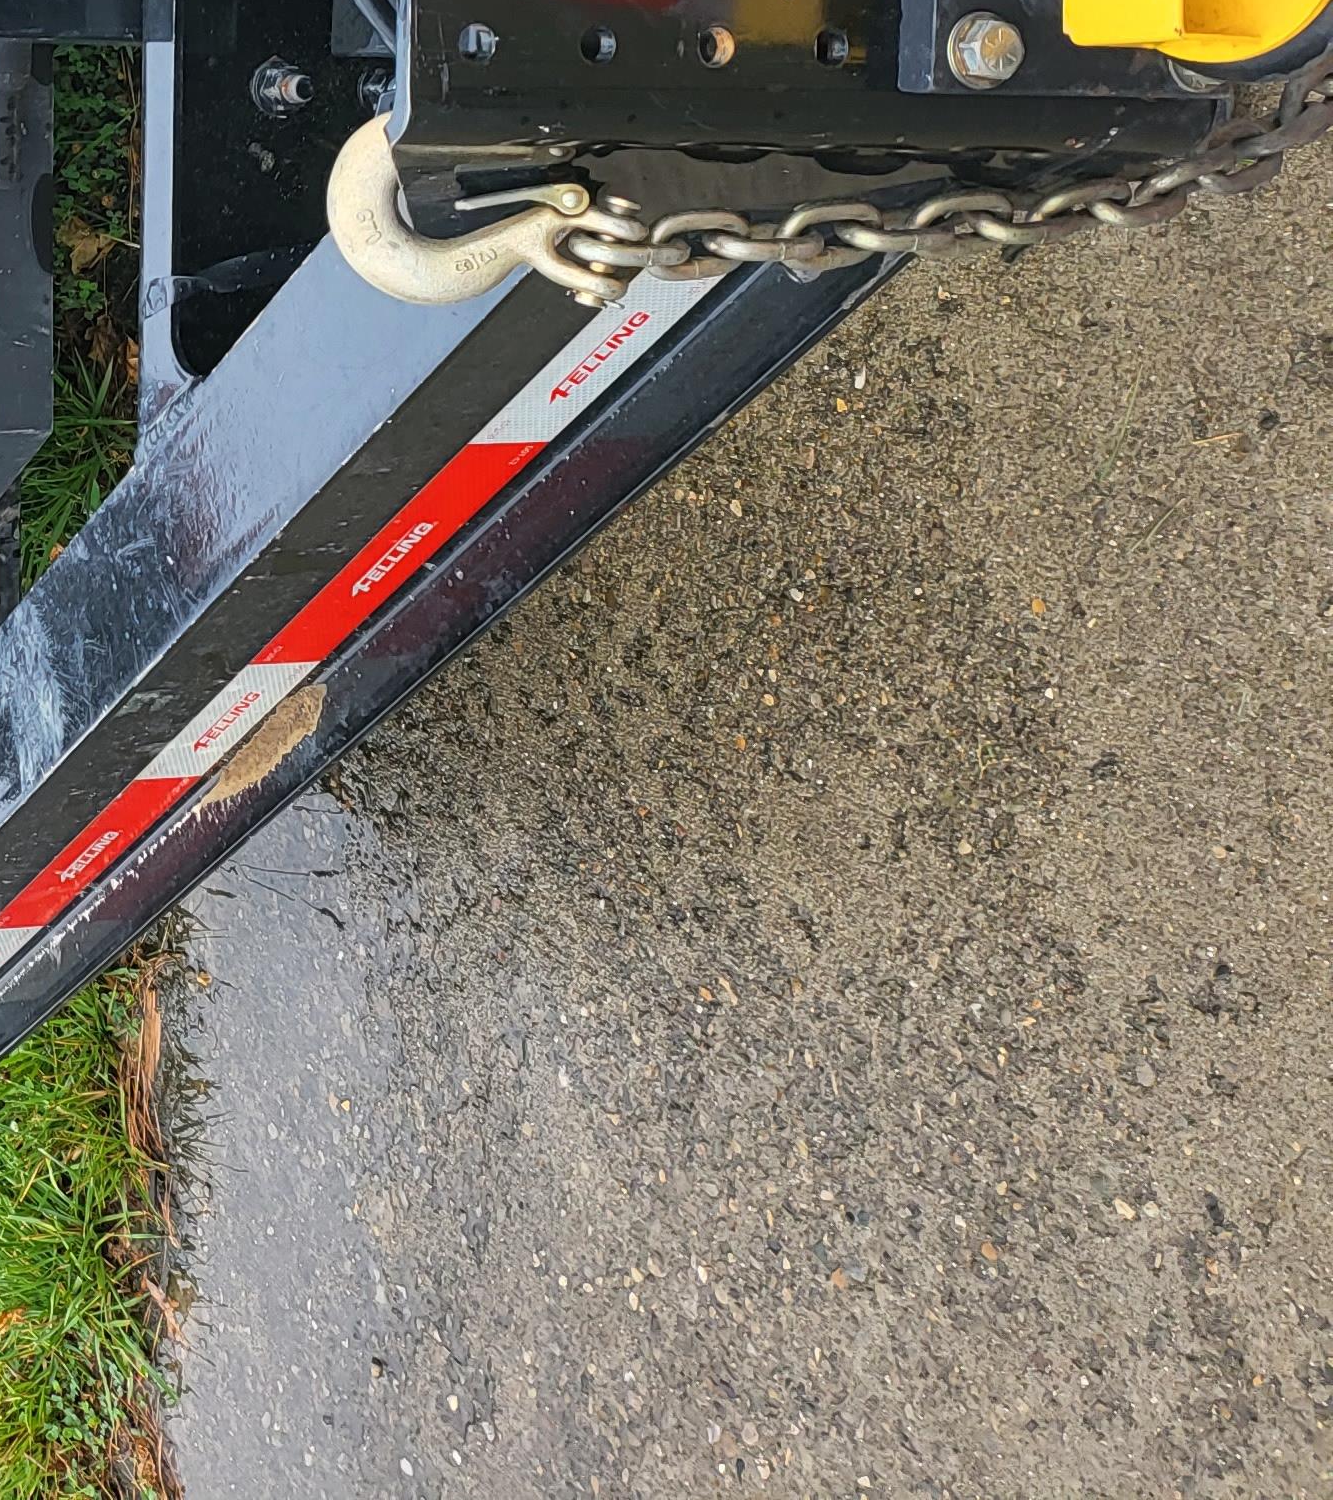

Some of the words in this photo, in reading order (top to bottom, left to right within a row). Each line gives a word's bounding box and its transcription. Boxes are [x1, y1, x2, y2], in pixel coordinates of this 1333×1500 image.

[548, 311, 650, 404] FELLING
[351, 520, 435, 596] FELLING
[193, 691, 261, 752] FELLING
[60, 830, 120, 883] FELLING
